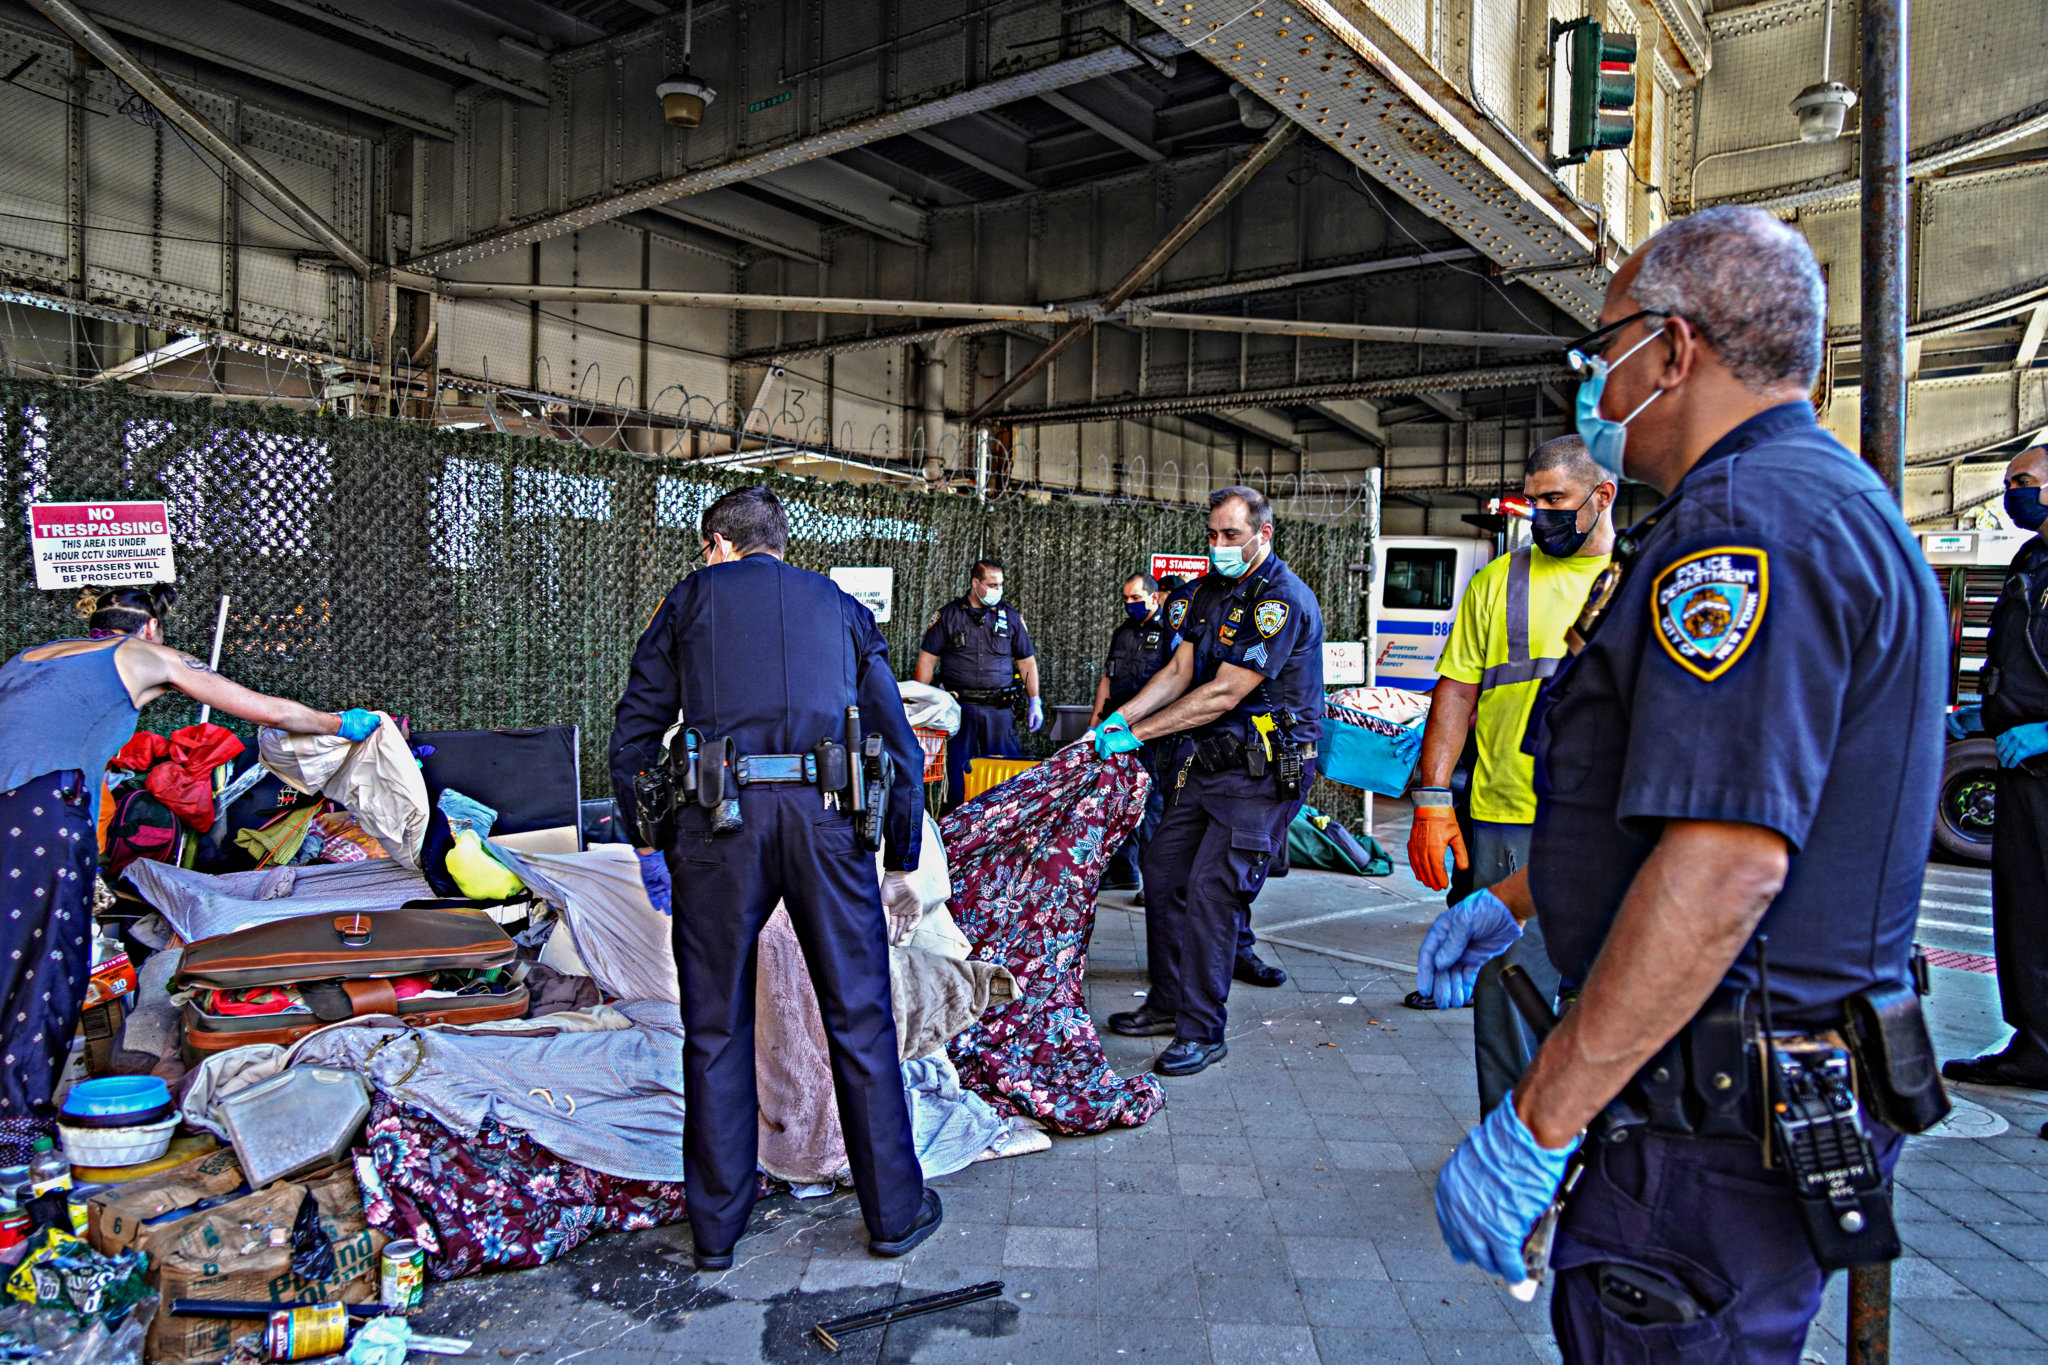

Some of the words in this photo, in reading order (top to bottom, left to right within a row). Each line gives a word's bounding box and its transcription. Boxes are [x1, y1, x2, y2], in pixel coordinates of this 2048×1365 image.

[88, 508, 114, 520] NO
[39, 521, 164, 537] TRESPASSING
[62, 540, 81, 549] THIS
[84, 539, 106, 548] AREA
[108, 538, 116, 547] IS
[118, 537, 146, 546] UNDER
[42, 553, 53, 561] 24
[55, 551, 80, 560] HOUR
[82, 550, 104, 559] CCTV
[106, 548, 166, 559] SURVEILLANCE
[53, 562, 131, 573] TRESPASSERS
[135, 561, 160, 570] WILL
[1155, 559, 1166, 568] NO
[1169, 560, 1205, 570] STANDING
[1675, 555, 1732, 579] POLICE
[63, 574, 78, 582] BE
[81, 571, 153, 582] PROSECUTED
[1660, 569, 1756, 605] DEPARTMENT
[1661, 617, 1682, 643] CITY
[1678, 643, 1698, 657] OF
[1715, 631, 1741, 660] NEW
[1736, 593, 1758, 628] YORK
[113, 1217, 122, 1235] 6
[268, 1229, 373, 1302] Pond
